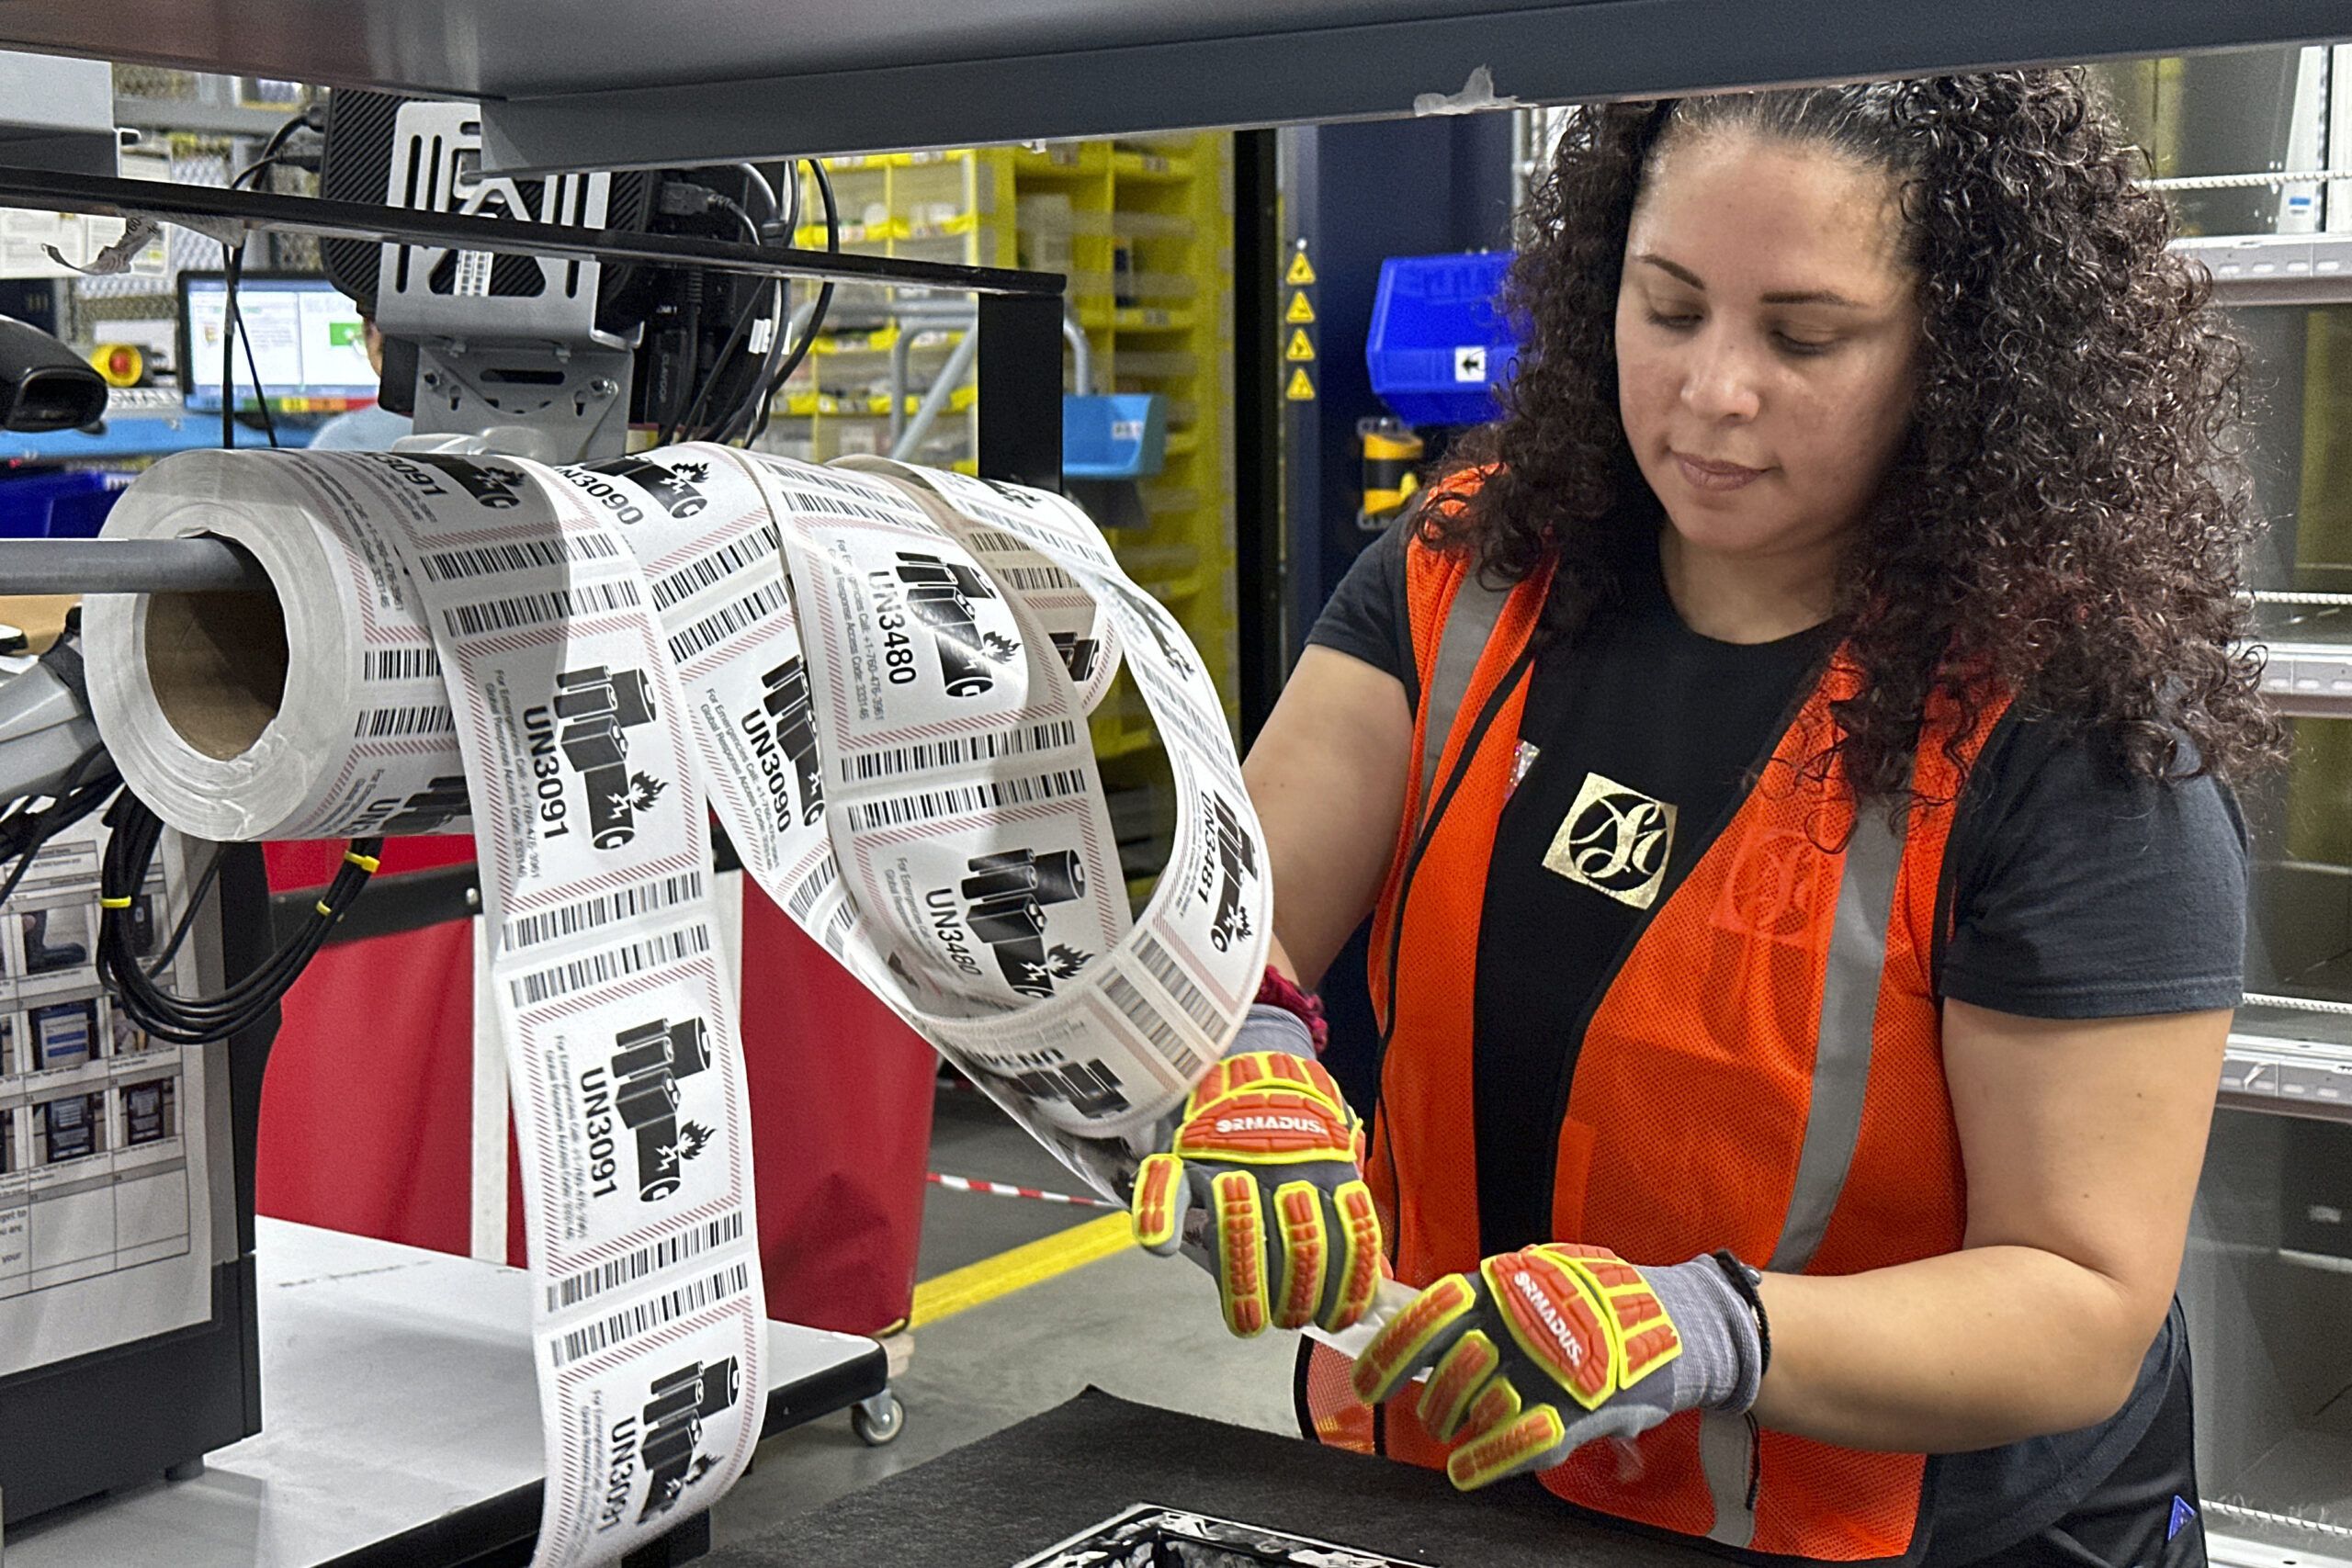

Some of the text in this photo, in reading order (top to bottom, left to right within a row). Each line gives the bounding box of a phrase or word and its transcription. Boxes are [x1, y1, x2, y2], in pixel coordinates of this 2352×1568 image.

[554, 466, 644, 525] N3090
[868, 571, 916, 684] UN3480
[523, 705, 570, 839] UN3091
[702, 704, 719, 731] Global
[717, 731, 741, 774] Response
[740, 775, 756, 807] Access
[707, 688, 718, 704] For
[717, 705, 748, 761] Emergencies
[741, 709, 791, 832] UN3090
[1196, 790, 1215, 907] UN3481
[926, 888, 983, 976] UN3480
[581, 1066, 617, 1199] UN3091
